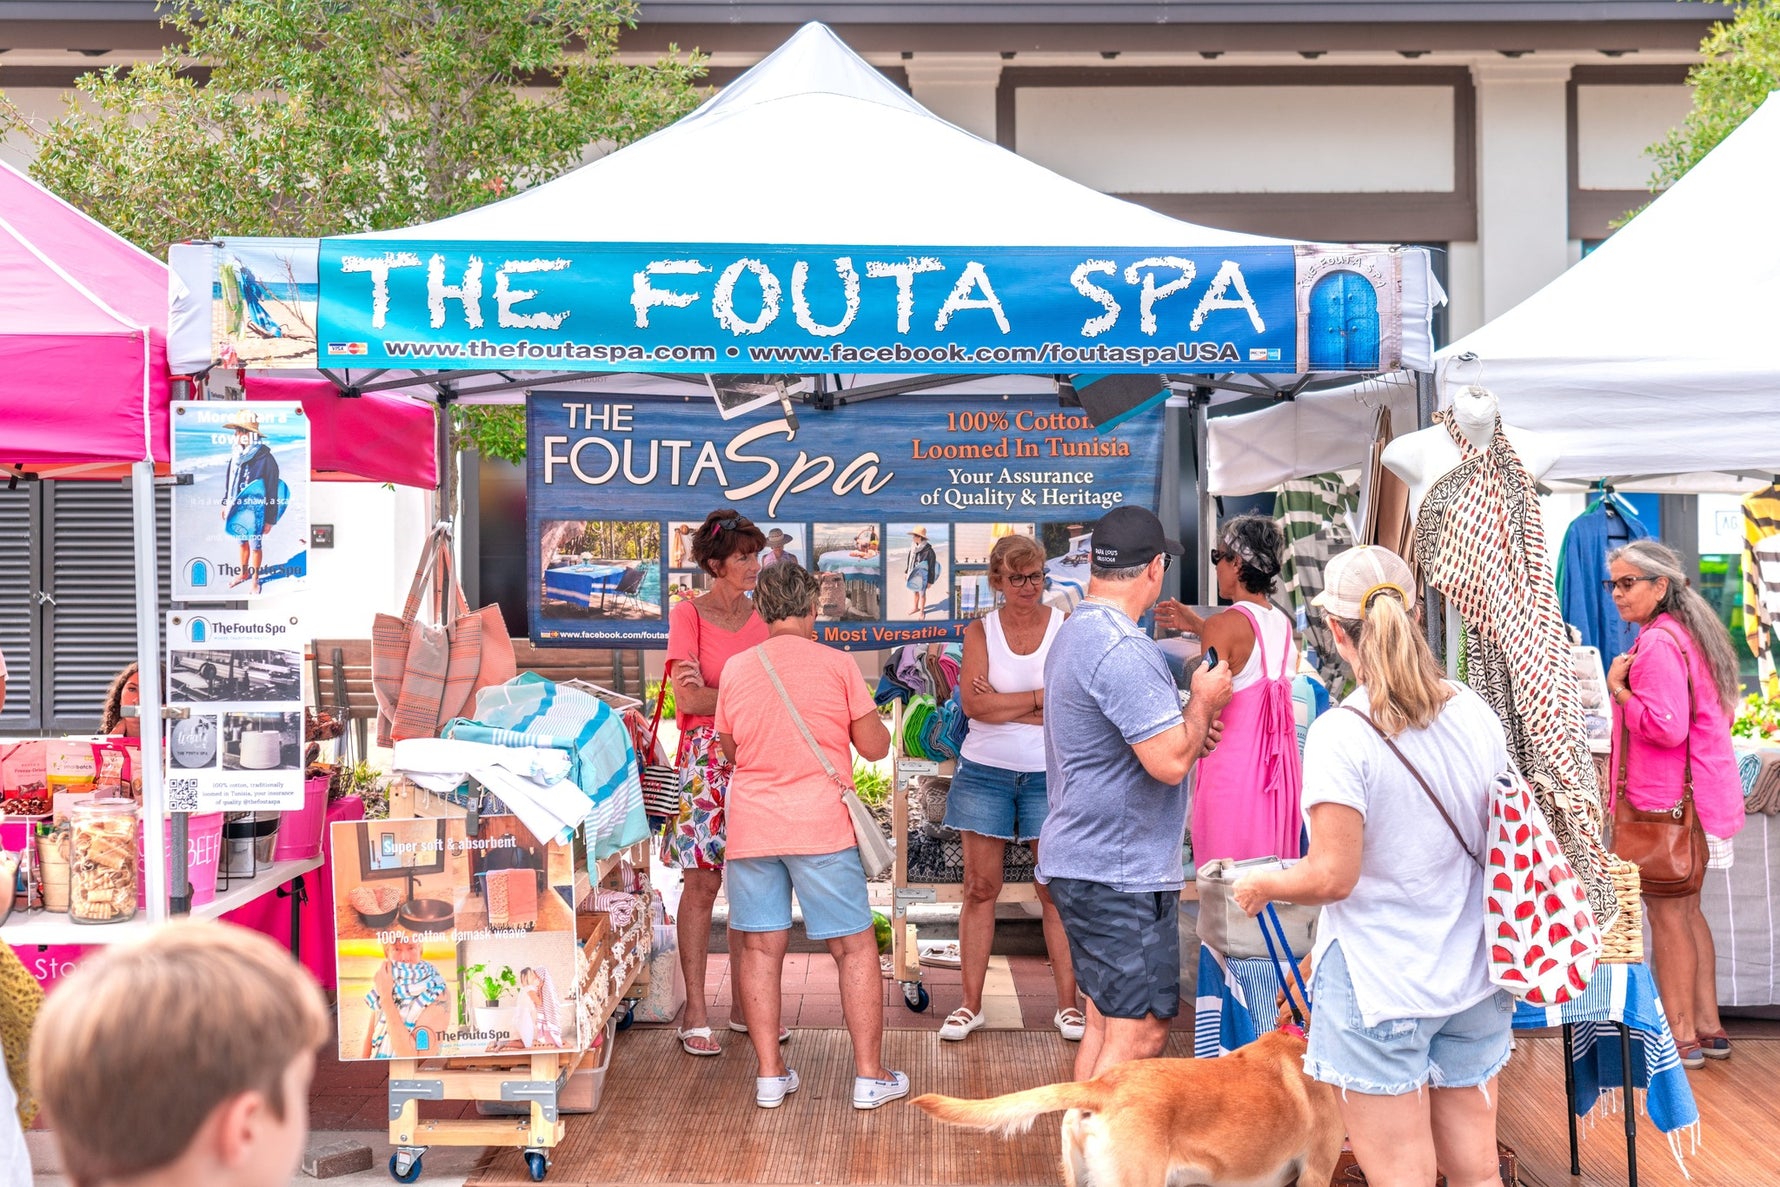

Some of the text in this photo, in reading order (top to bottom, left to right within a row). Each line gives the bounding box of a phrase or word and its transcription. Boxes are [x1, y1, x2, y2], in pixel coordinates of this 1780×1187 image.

[1320, 255, 1361, 268] FOUTA
[1367, 264, 1386, 289] SPA
[341, 252, 1265, 338] THE FOUTA SPA
[385, 341, 1239, 367] www.thefoutaspa.com www.facebook.com/foutaspaUSA
[197, 411, 235, 424] More
[278, 414, 288, 424] a
[561, 402, 634, 432] THE
[946, 411, 1009, 432] 100%
[911, 437, 1131, 459] Loomed In Tunisia
[543, 418, 894, 518] FOUTA Spa
[948, 467, 1094, 485] Your Assurance
[920, 487, 1123, 511] of Quality & Heritage
[560, 631, 669, 640] www.facebook.com/foutas
[824, 627, 867, 642] Most
[872, 626, 947, 641] Versatile
[384, 835, 516, 854] Super soft & absorbent
[376, 930, 409, 945] 100%
[451, 927, 491, 943] damask
[494, 927, 526, 940] weave
[35, 958, 78, 980] Sto
